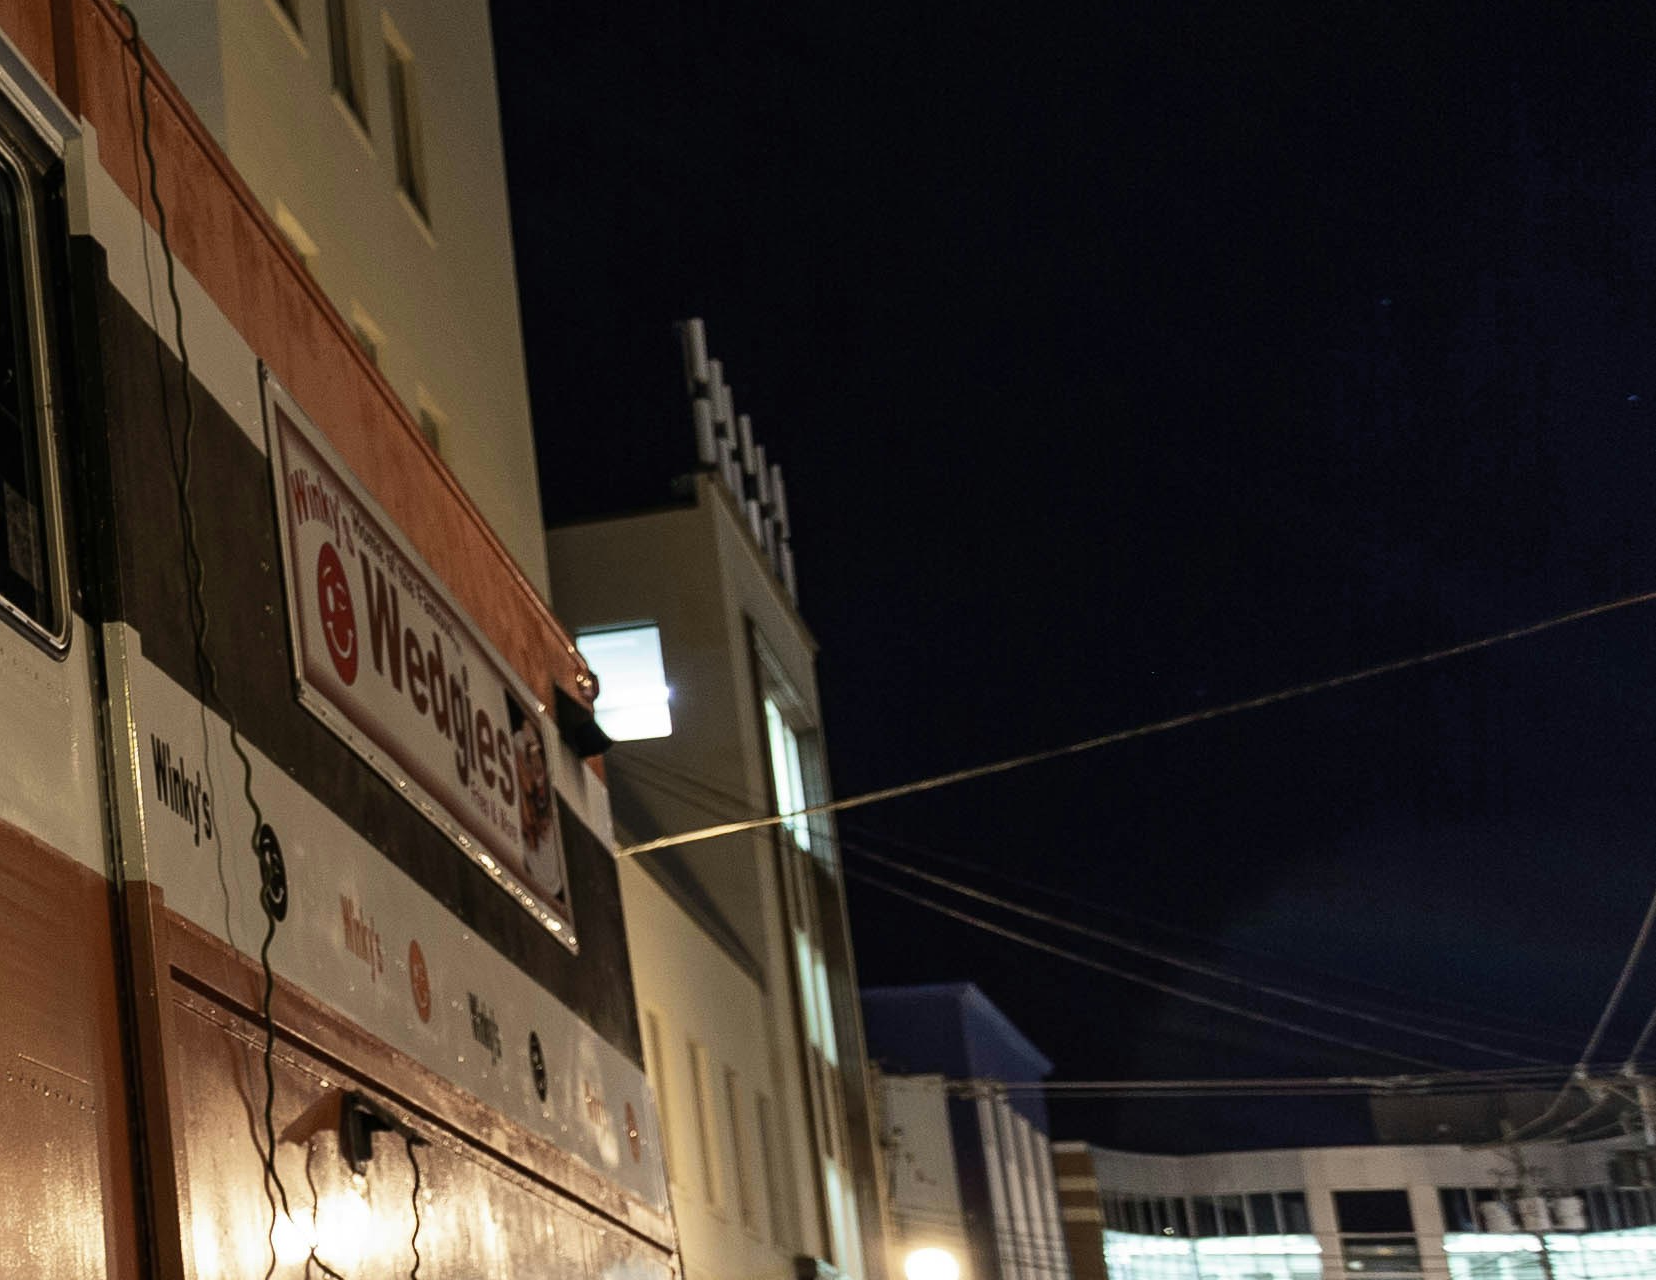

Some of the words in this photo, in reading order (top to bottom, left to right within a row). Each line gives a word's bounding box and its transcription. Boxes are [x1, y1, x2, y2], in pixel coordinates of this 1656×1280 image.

[290, 468, 356, 558] Winky's
[360, 549, 516, 807] Wedgies
[151, 733, 213, 847] Winky's
